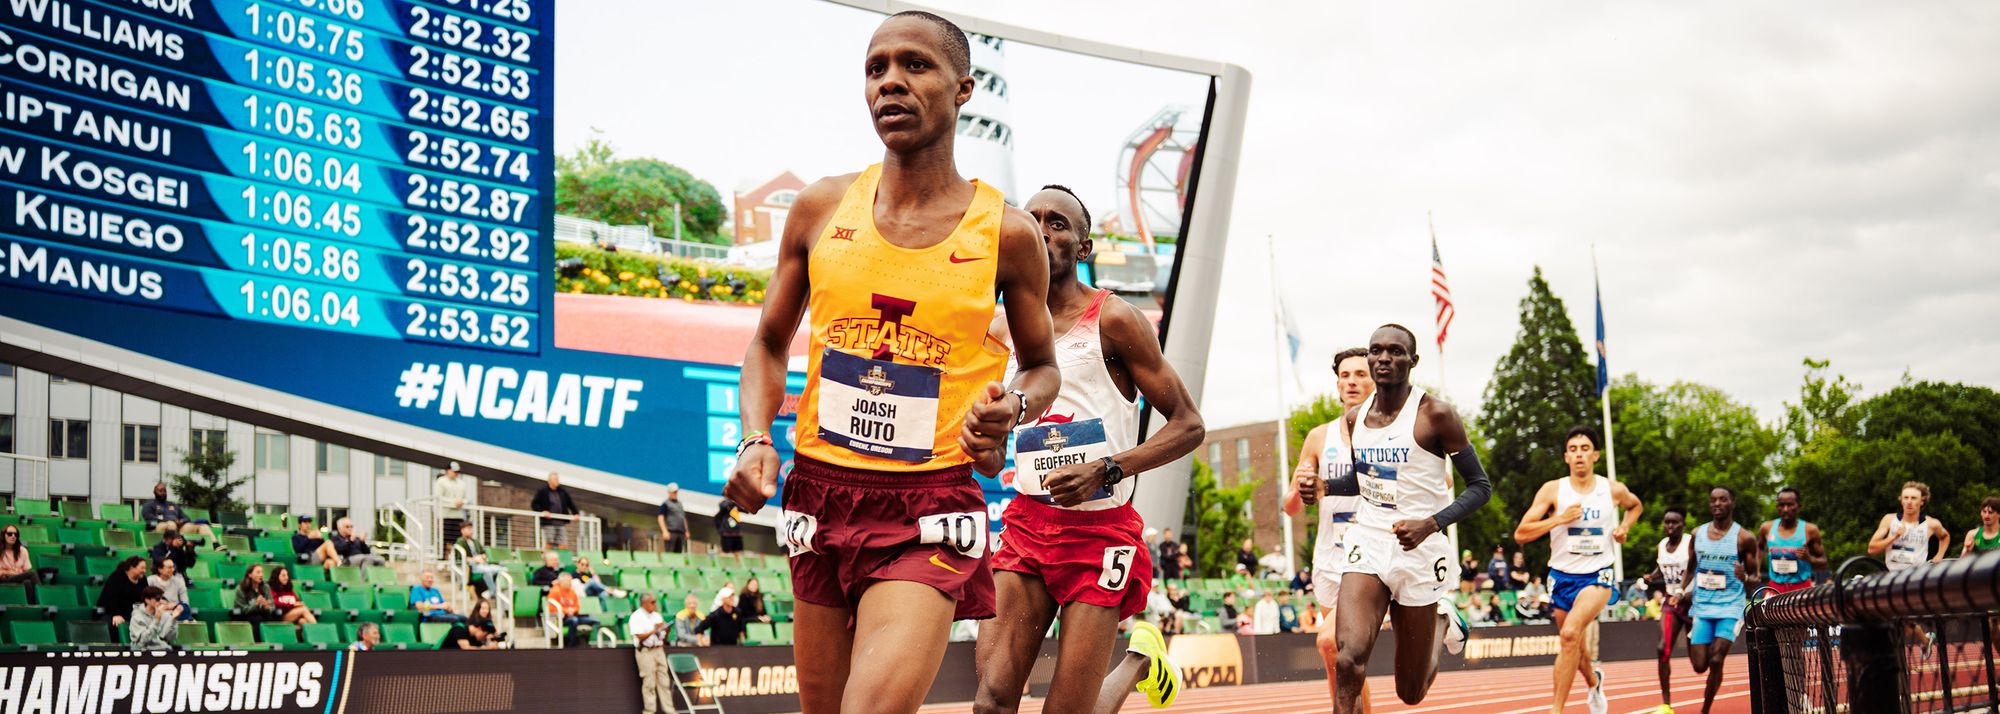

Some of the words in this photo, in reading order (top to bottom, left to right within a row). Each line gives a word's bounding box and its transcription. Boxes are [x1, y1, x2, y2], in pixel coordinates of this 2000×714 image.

[245, 3, 364, 61] 1:05.75
[409, 45, 530, 100] 2:52.53
[410, 5, 530, 63] 2:52.32
[10, 0, 185, 61] WILLIAMS
[244, 49, 363, 105] 1:05.36
[408, 87, 530, 141] 2:52.65
[0, 88, 171, 156] IPTANUI
[243, 141, 362, 194] 1:06.04
[407, 173, 530, 223] 2:52.87
[243, 95, 362, 149] 1:05.63
[408, 130, 530, 182] 2:52.74
[41, 146, 188, 208] KOSGEI
[242, 185, 362, 237] 1:06.45
[406, 214, 529, 263] 2:52.92
[16, 190, 184, 252] KIBIEGO
[241, 232, 361, 282] 1:05.86
[406, 258, 529, 306] 2:53.25
[831, 226, 857, 241] XII
[0, 242, 163, 300] MANUS
[240, 280, 361, 328] 1:06.04
[406, 302, 529, 348] 2:53.52
[825, 318, 951, 370] STATE
[394, 361, 644, 429] #NCAATF
[724, 388, 734, 411] 1
[852, 398, 897, 419] JOASH
[722, 422, 737, 445] 2
[850, 416, 895, 442] RUTO
[1034, 452, 1086, 471] GEOFFREY
[1354, 447, 1409, 463] ENTUCKY
[1582, 507, 1600, 521] YU
[934, 515, 977, 553] 10
[1107, 549, 1130, 588] 5
[1348, 545, 1361, 563] 6
[1434, 557, 1447, 582] 6
[1181, 666, 1236, 688] NCAA
